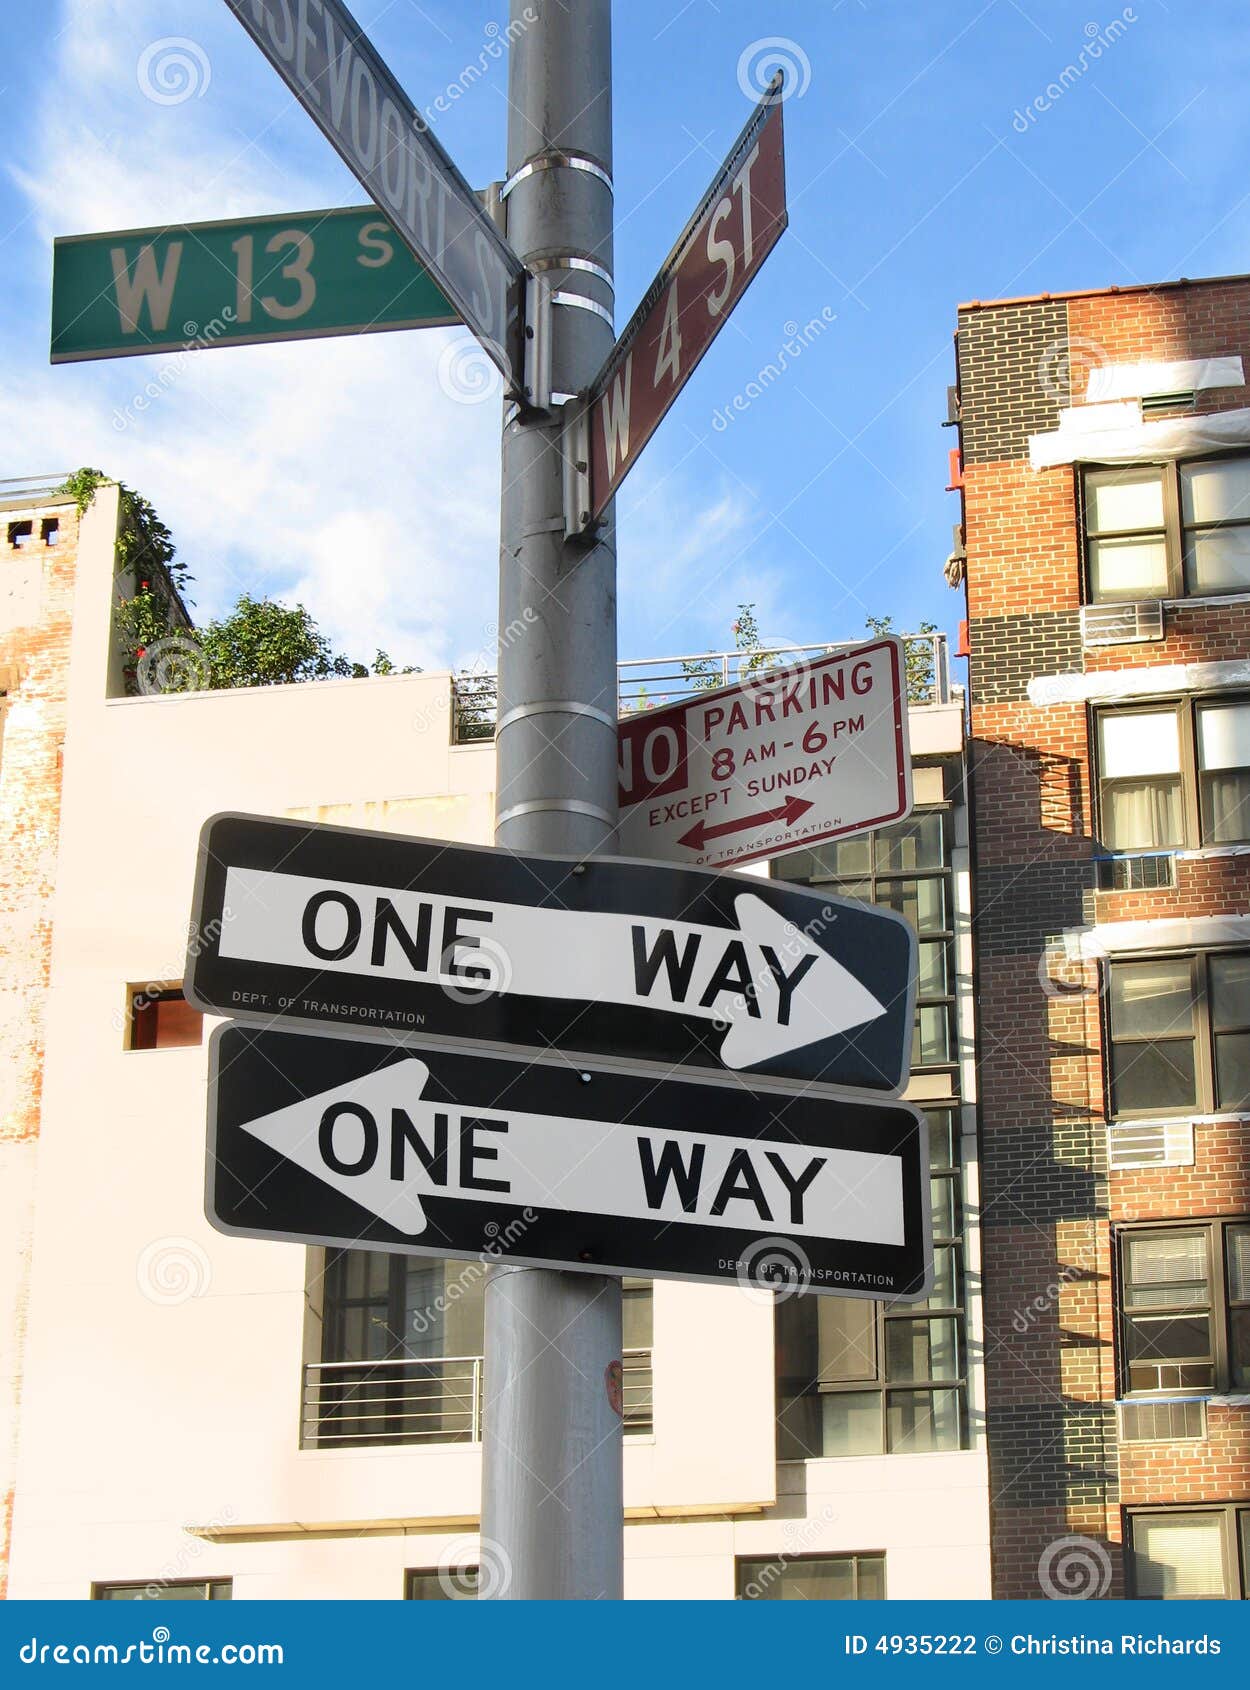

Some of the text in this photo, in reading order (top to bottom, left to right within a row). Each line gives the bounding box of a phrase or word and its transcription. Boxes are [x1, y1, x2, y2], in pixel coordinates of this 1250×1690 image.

[250, 0, 450, 268] SEVOORT
[110, 222, 396, 335] W 13 S
[600, 141, 760, 484] W 4 ST
[617, 661, 873, 793] NO PARKING
[649, 756, 837, 827] EXCEPT SUNDAY
[719, 817, 843, 859] TRANSPORTATION
[232, 991, 426, 1025] DEPT. OF TRANSPORTATION
[302, 890, 819, 1026] ONE WAY
[318, 1101, 828, 1225] ONE WAY
[760, 1263, 777, 1275] OF
[783, 1265, 895, 1287] TRANSPORTATION
